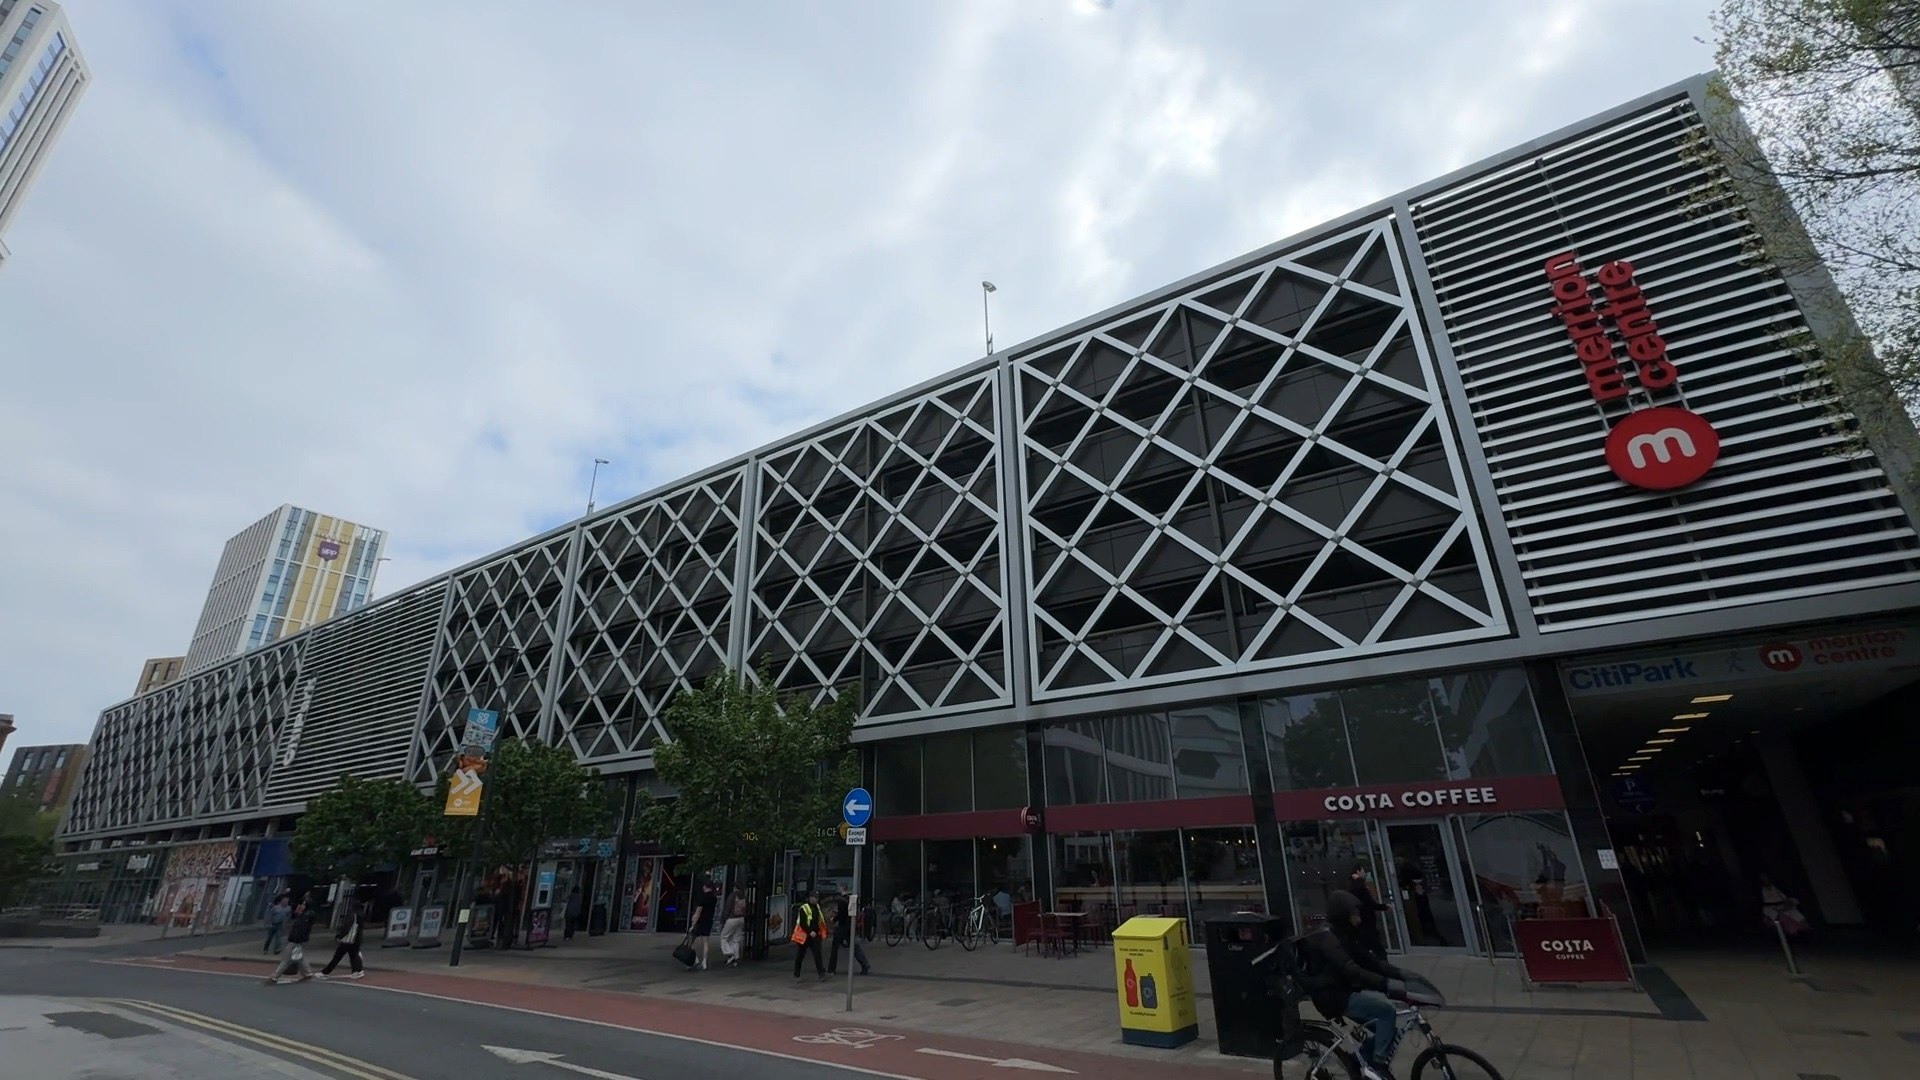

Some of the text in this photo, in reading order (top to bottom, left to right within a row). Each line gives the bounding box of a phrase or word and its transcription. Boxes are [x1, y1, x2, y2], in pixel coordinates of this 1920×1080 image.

[1544, 251, 1629, 402] merrion
[1598, 260, 1678, 390] centre
[1627, 427, 1696, 469] m
[1809, 631, 1905, 651] merrion
[1767, 649, 1795, 665] m
[1814, 646, 1896, 665] centre
[1569, 657, 1698, 690] CitiPark
[1324, 786, 1497, 812] COSTA COFFEE
[848, 829, 865, 837] Except
[1540, 939, 1595, 953] COSTA
